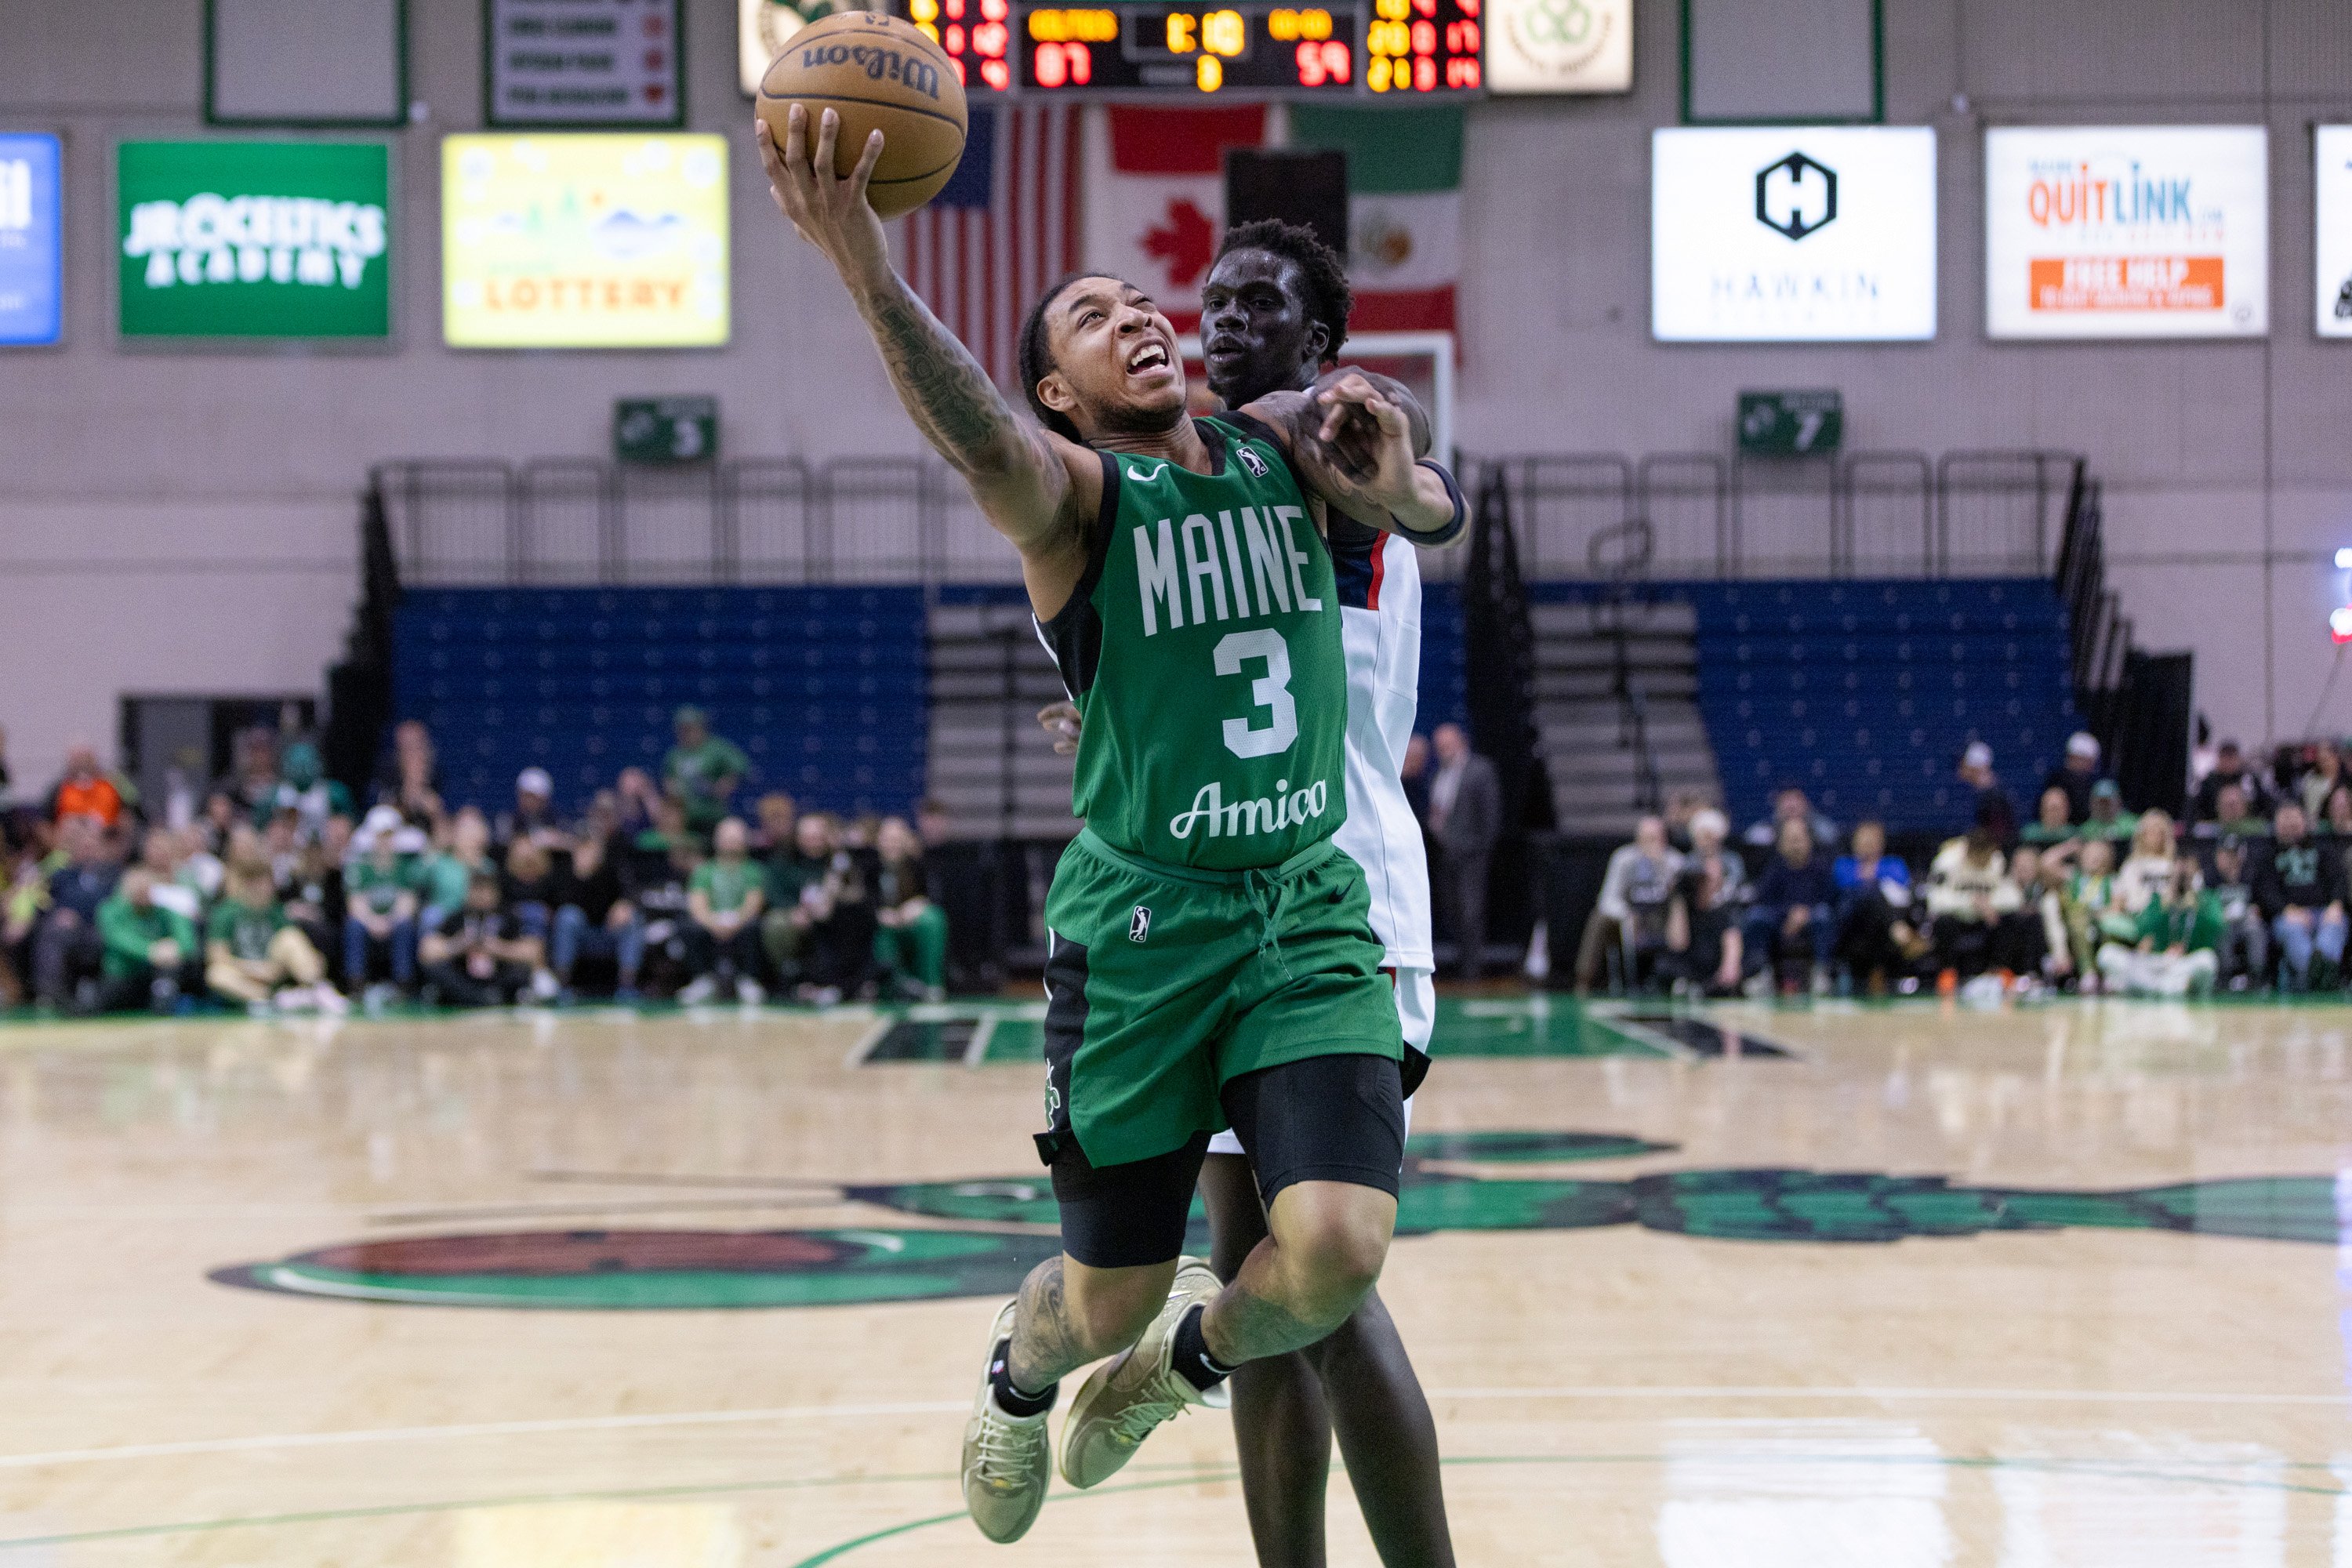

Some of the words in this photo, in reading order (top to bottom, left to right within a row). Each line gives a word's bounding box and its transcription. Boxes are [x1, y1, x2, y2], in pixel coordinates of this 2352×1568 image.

[802, 44, 939, 100] Wilson
[485, 278, 689, 311] LOTTERY
[1133, 504, 1322, 637] MAINE
[1212, 628, 1298, 759] 3
[1170, 779, 1326, 840] Amico
